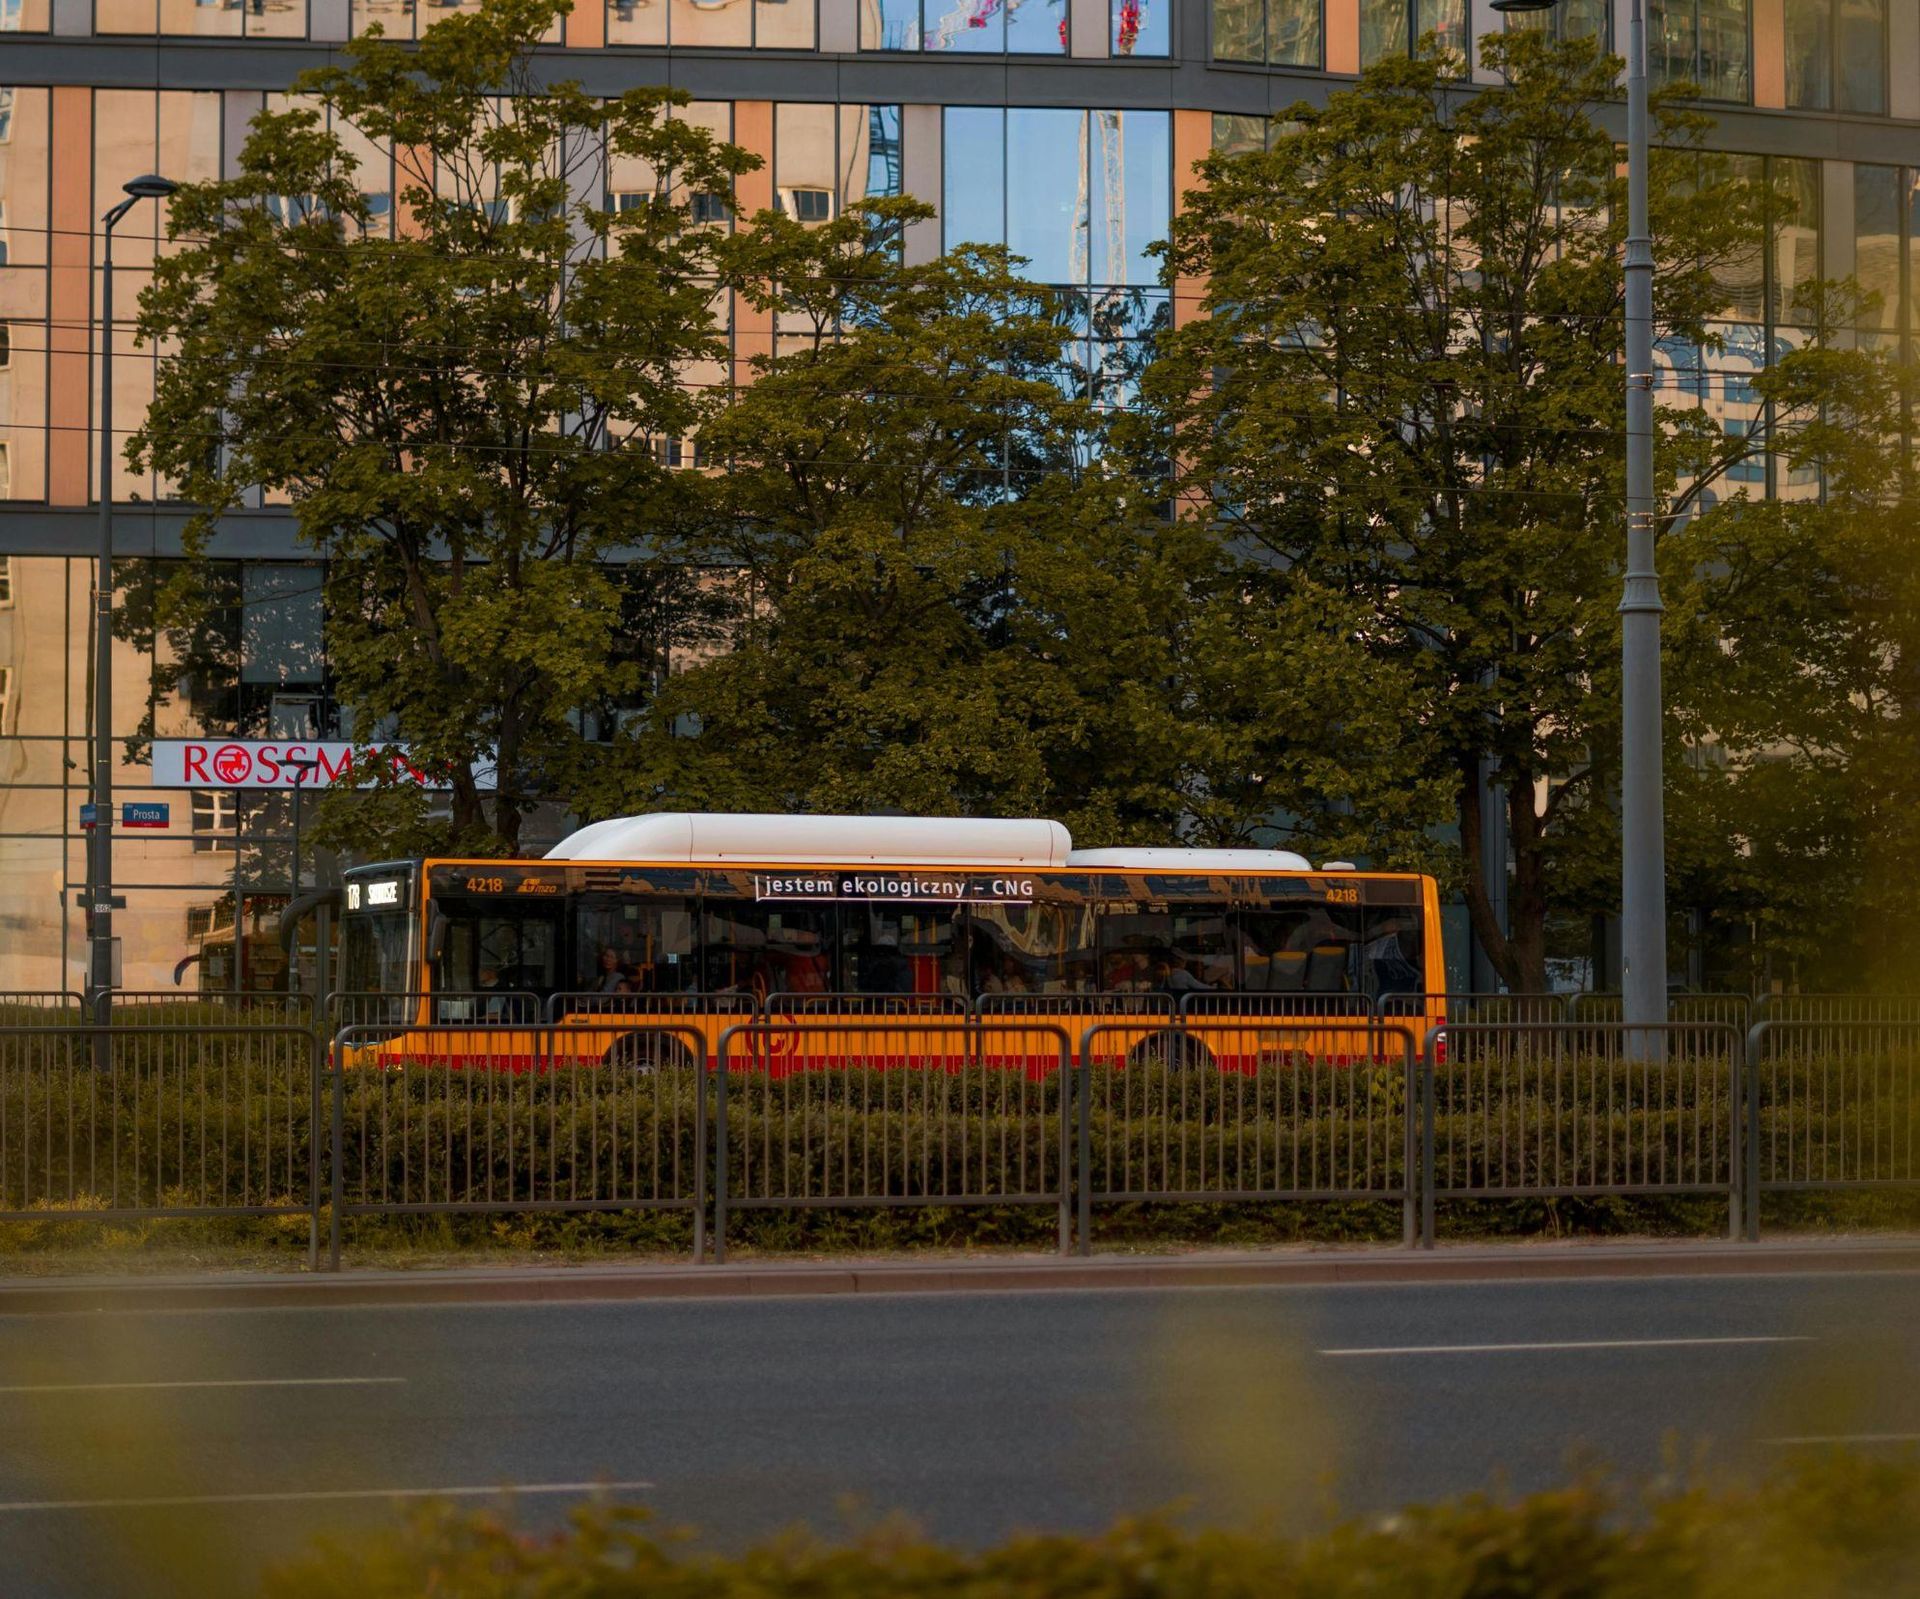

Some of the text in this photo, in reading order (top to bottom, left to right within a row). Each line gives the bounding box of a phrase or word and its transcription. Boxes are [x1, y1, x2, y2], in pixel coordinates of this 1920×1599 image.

[184, 744, 462, 784] ROSSMN
[133, 808, 160, 820] Prosta
[467, 878, 503, 892] 4218
[765, 876, 833, 896] jestem
[842, 877, 966, 898] ekologiczny
[992, 880, 1033, 895] CNG
[347, 884, 360, 909] 178
[1326, 889, 1357, 902] 4218
